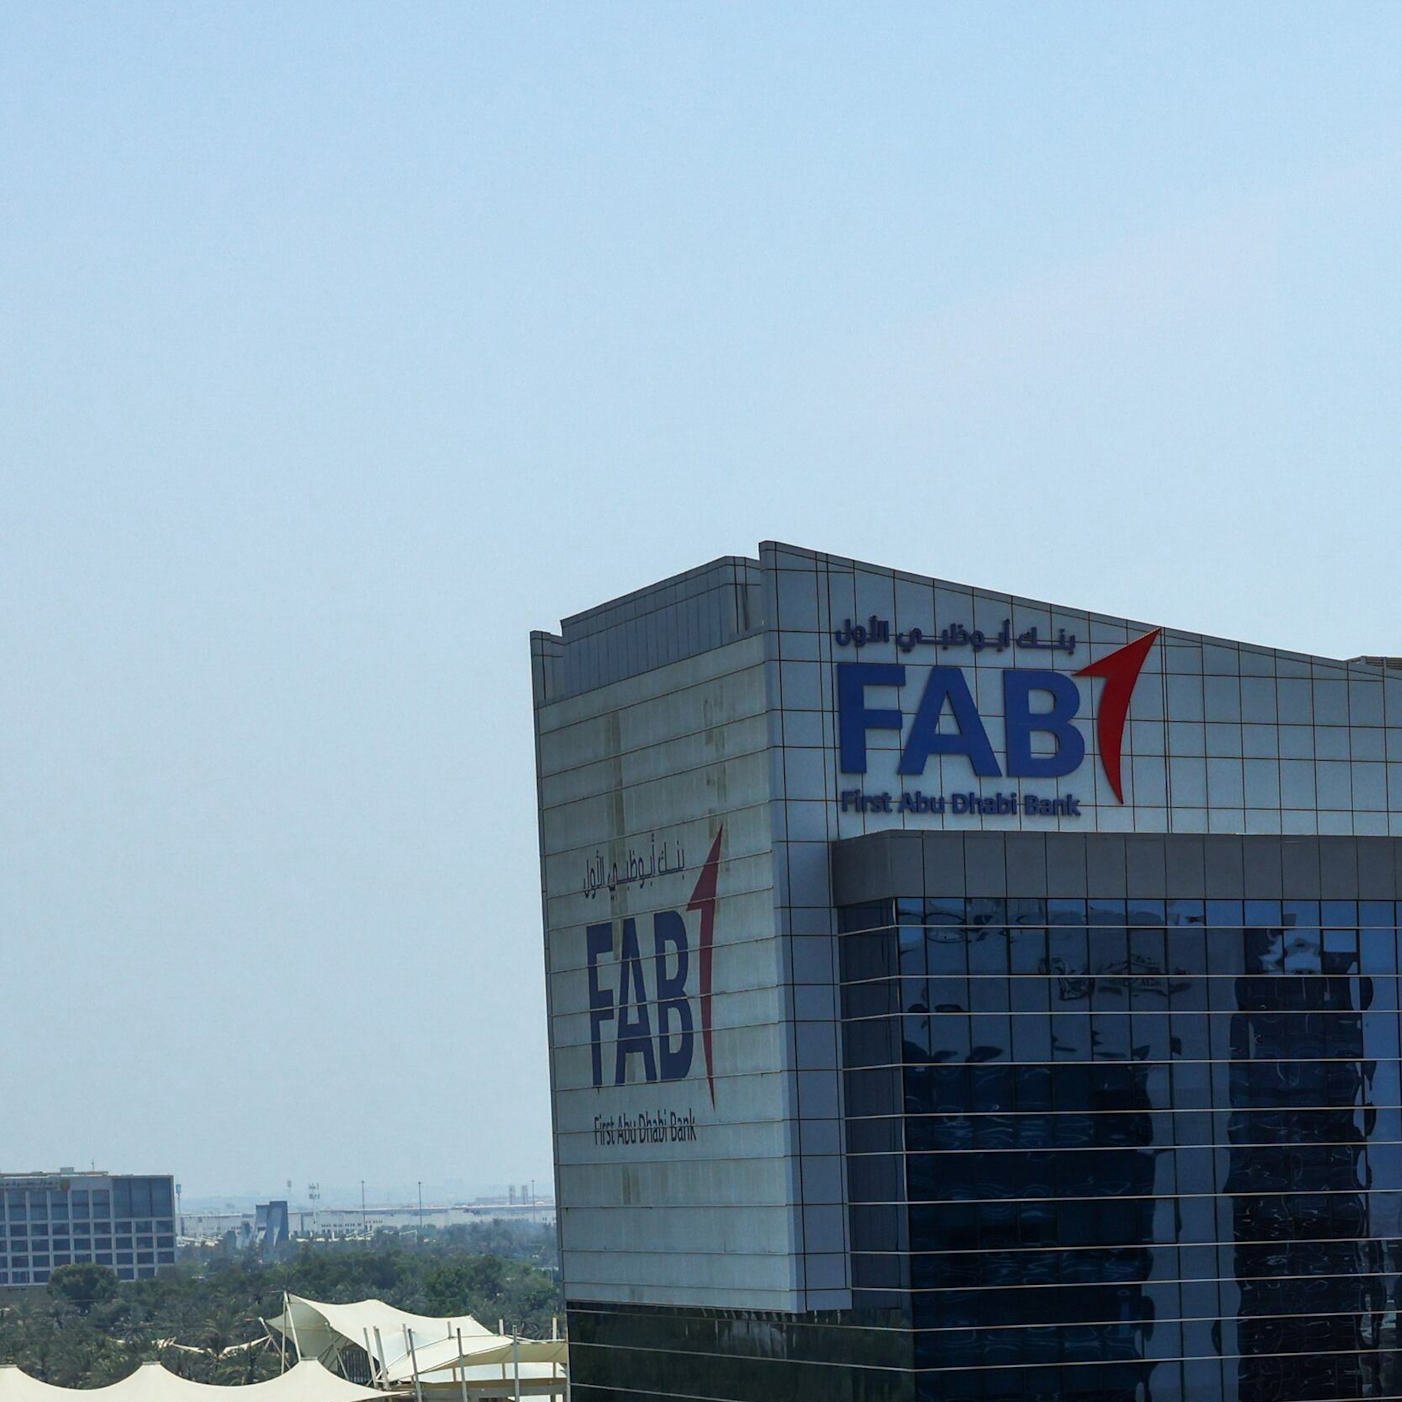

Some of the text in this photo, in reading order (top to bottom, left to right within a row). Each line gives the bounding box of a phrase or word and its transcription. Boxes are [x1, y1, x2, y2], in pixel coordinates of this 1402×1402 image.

[835, 614, 1076, 656] بنك أبوظبي الأول
[837, 663, 1085, 778] FAB
[841, 788, 1082, 817] First Abu Dhabi Bank
[607, 832, 656, 901] أبوظبي
[658, 839, 685, 881] بنك
[586, 909, 694, 1089] FAB
[594, 1107, 697, 1146] First Abu Dhabi Bank
